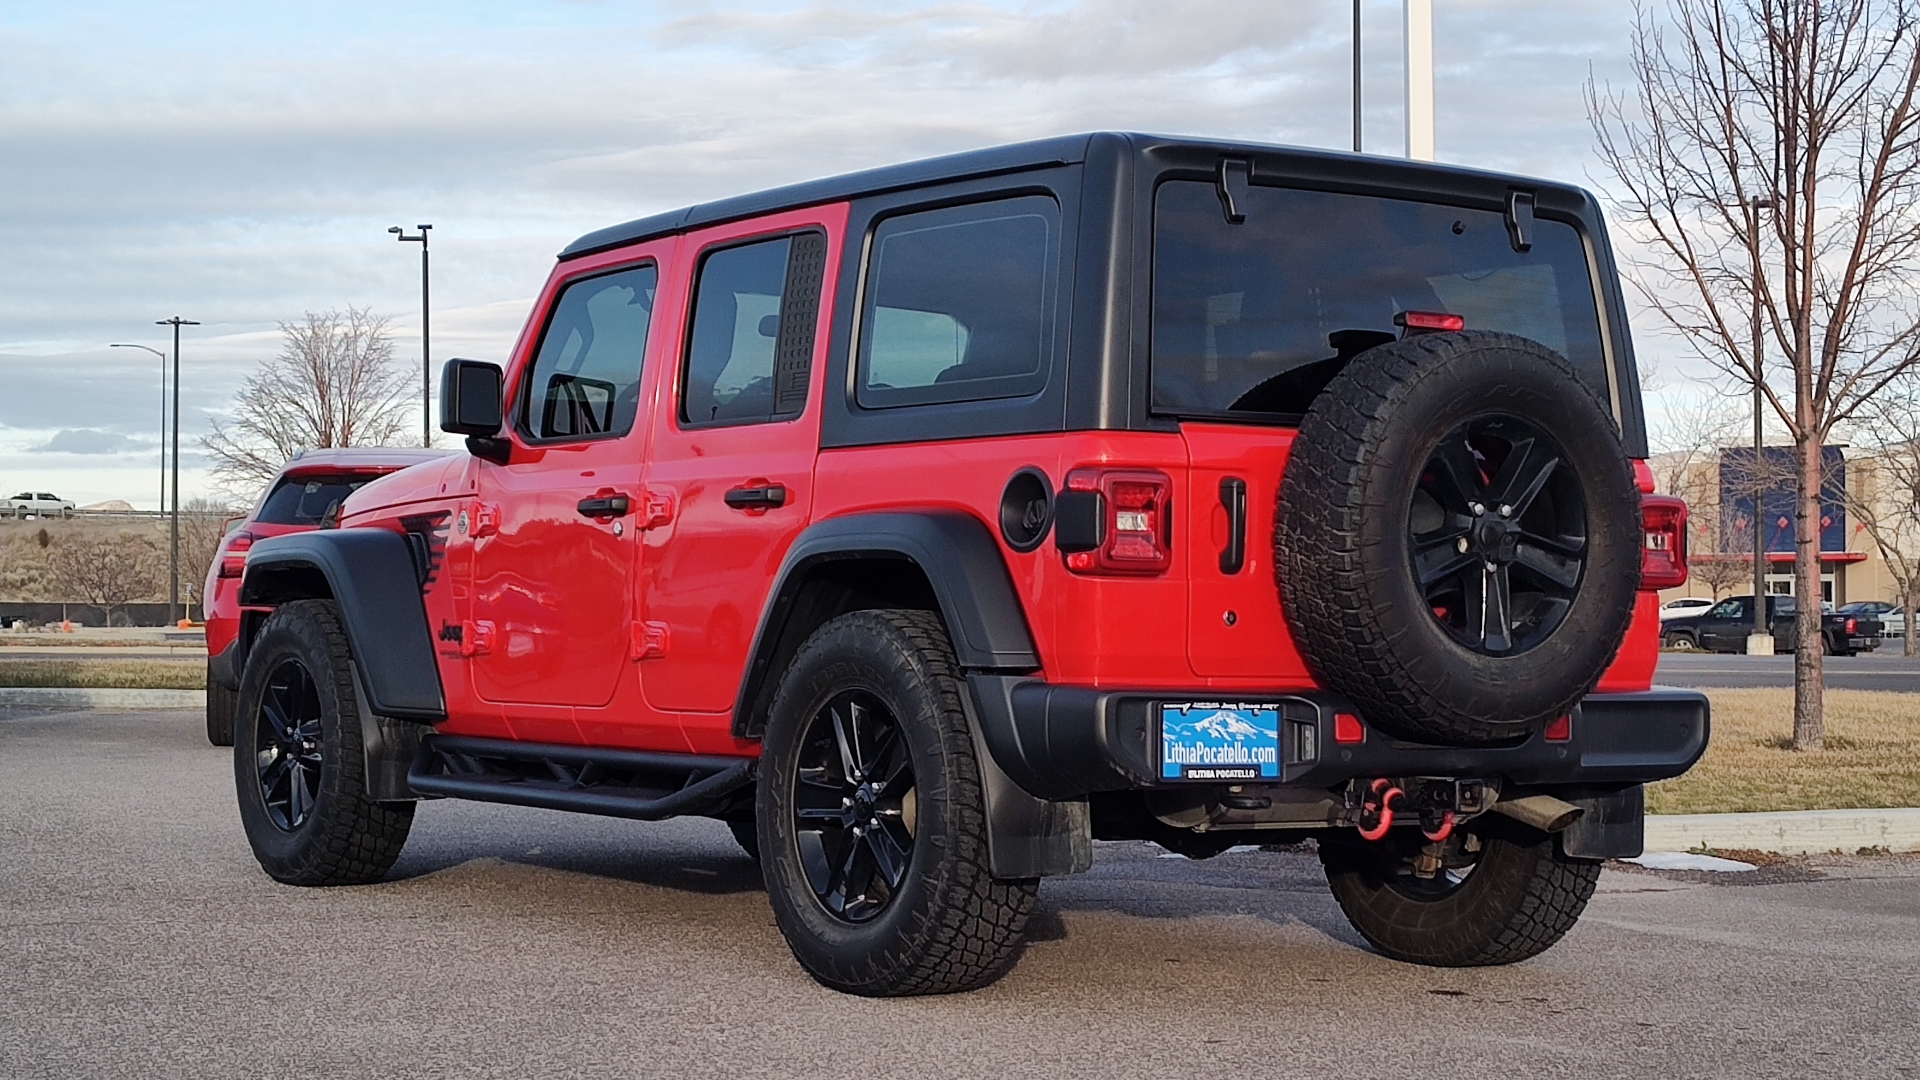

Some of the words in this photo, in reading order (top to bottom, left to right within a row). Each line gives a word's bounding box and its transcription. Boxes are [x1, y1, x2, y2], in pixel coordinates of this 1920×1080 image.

[438, 618, 463, 647] Jeep
[1164, 741, 1275, 763] LithiaPocatello.com
[1216, 769, 1255, 779] POCATELLO
